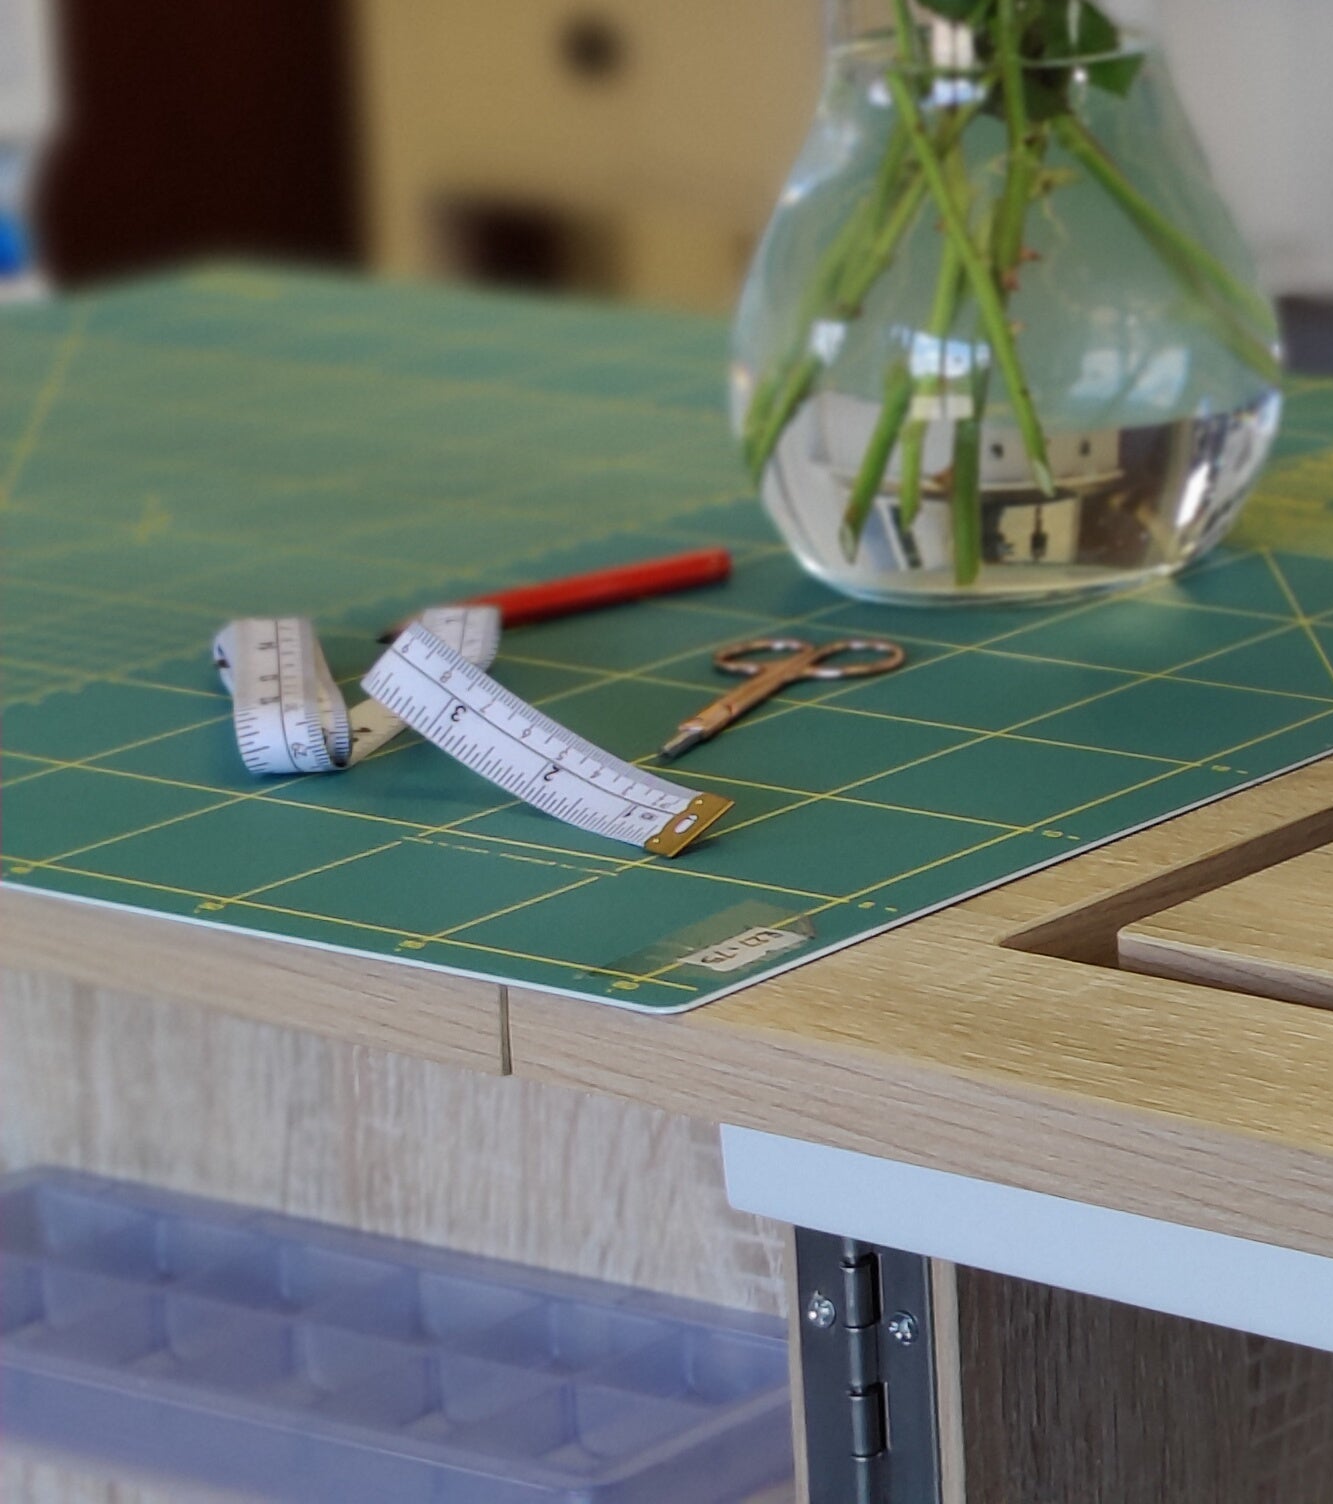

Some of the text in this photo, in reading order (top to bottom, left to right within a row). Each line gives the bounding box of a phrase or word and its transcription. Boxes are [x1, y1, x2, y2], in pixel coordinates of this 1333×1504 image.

[439, 670, 452, 683] 8
[451, 705, 467, 722] 3
[544, 765, 561, 782] 2
